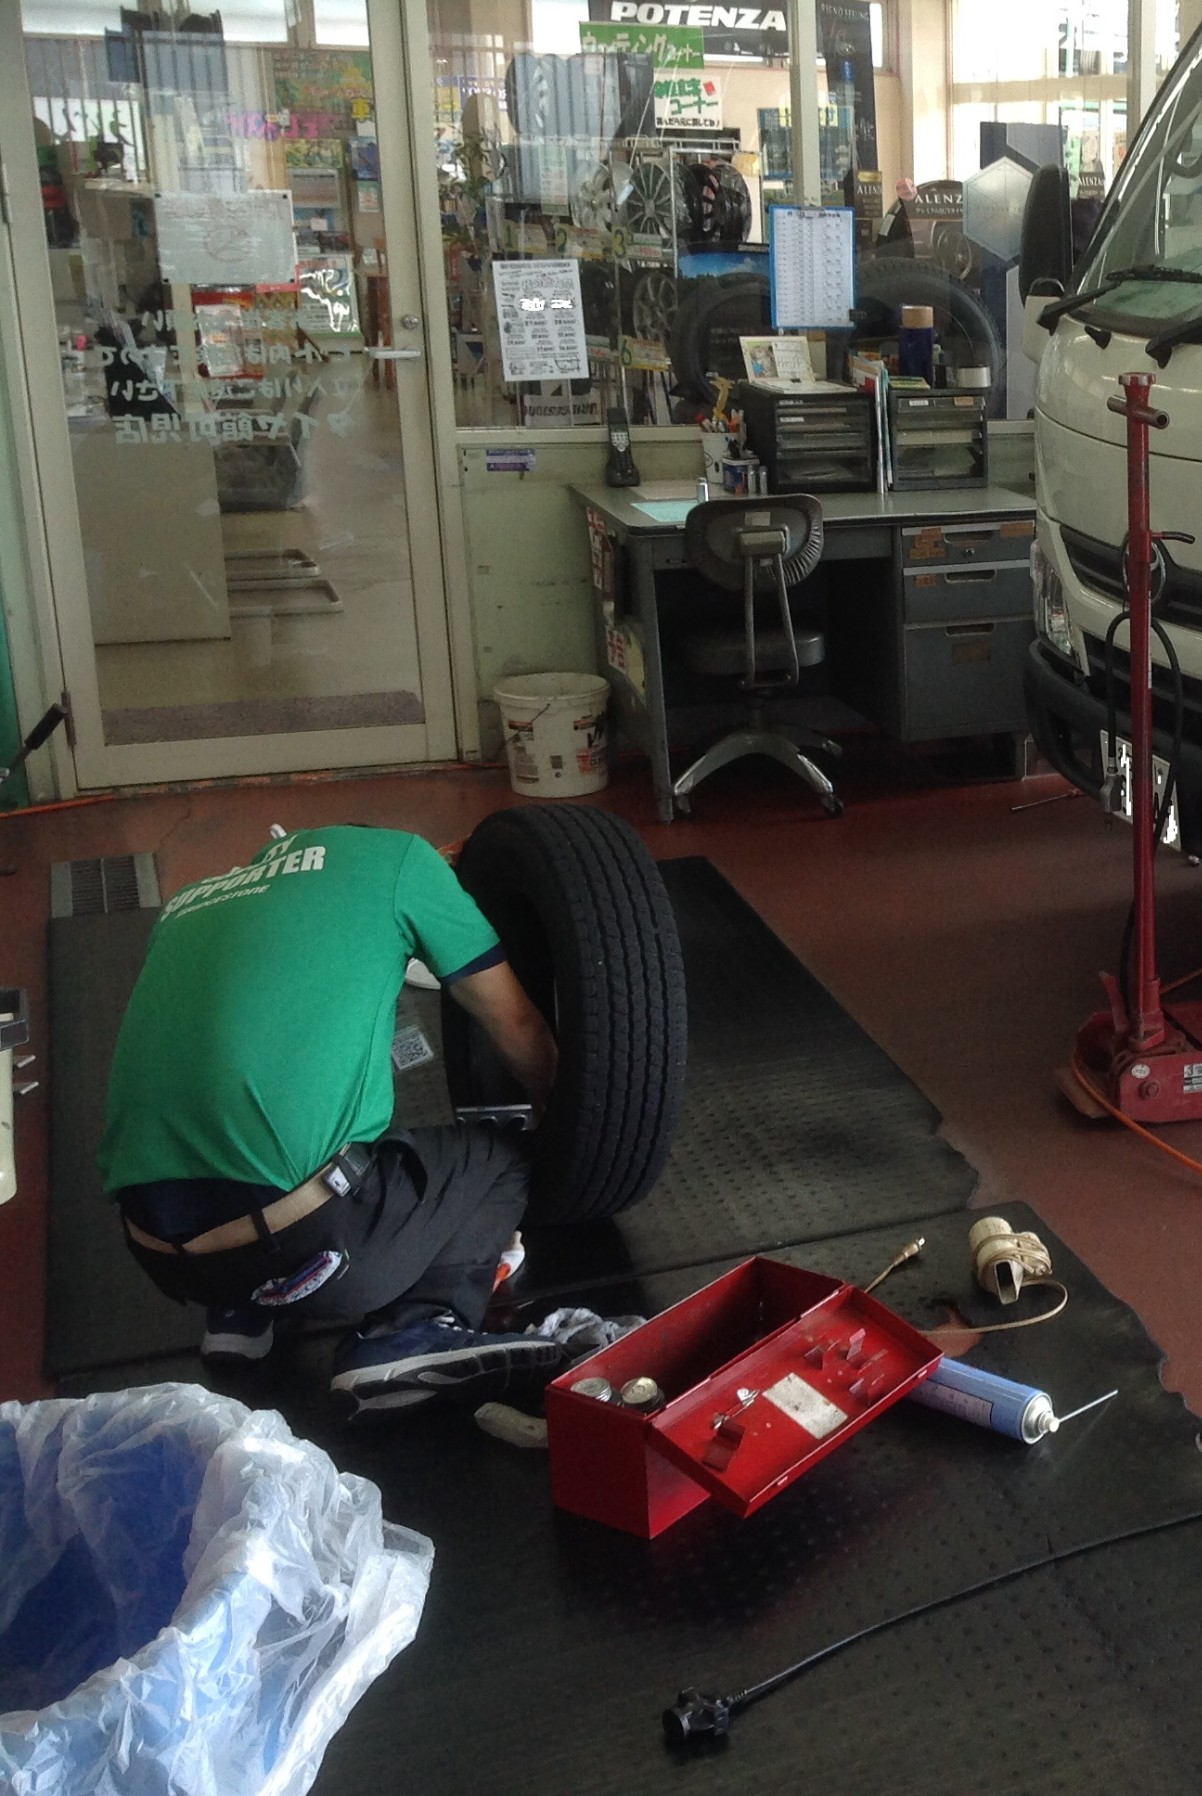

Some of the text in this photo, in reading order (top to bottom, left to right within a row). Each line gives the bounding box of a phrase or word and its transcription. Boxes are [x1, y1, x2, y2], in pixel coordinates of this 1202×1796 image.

[611, 1, 787, 31] POTENZA
[914, 193, 963, 204] ALENZ
[161, 846, 326, 922] SUPPORTER
